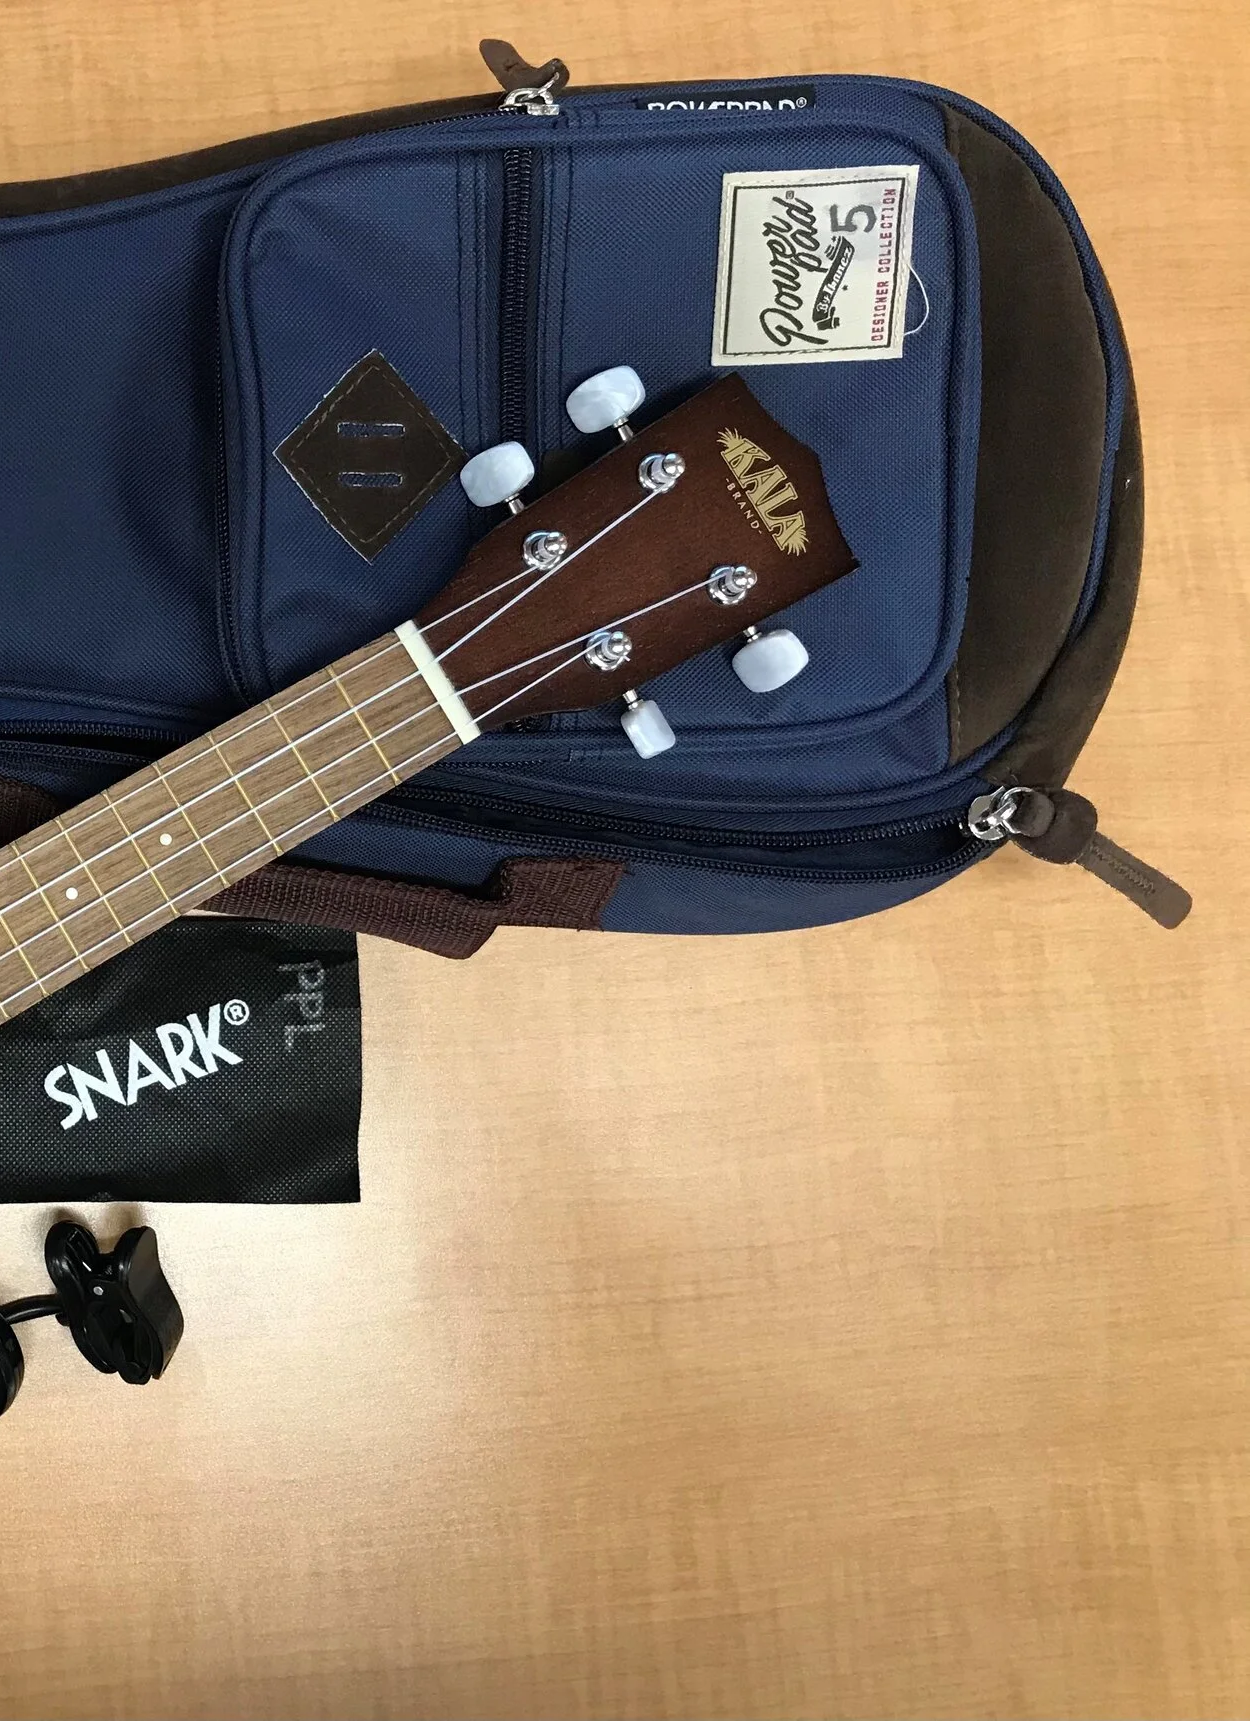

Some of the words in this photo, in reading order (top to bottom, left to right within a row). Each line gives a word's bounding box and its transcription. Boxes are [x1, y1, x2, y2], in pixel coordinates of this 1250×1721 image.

[830, 203, 878, 235] 5
[877, 187, 898, 274] COLLECTION
[824, 246, 854, 295] Ibanez
[871, 279, 890, 342] DESIGNER
[720, 436, 807, 552] KALA
